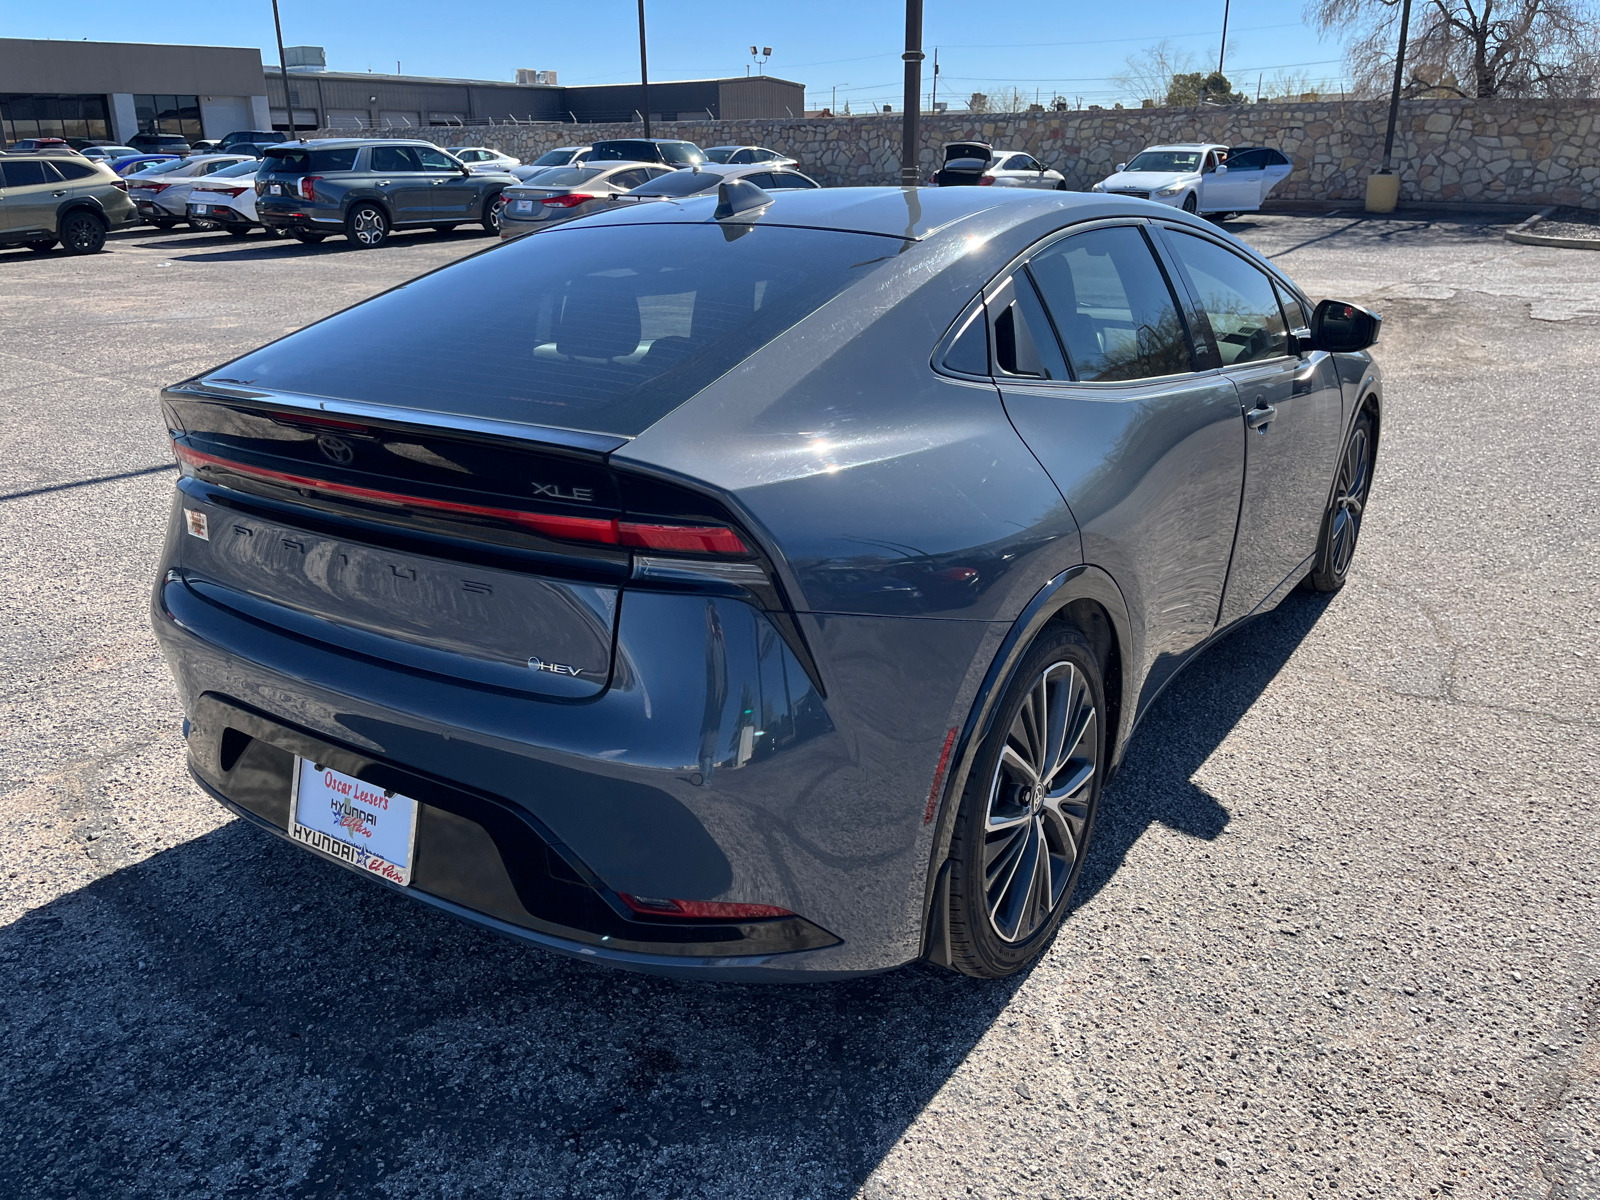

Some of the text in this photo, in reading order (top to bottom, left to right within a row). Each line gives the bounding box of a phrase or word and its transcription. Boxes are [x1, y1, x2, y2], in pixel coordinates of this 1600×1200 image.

[531, 482, 593, 501] XLE
[233, 524, 494, 596] PRIUS
[540, 661, 584, 676] HEV
[324, 771, 389, 811] Oscar Leeser's
[330, 798, 377, 827] HYUNDAI
[341, 816, 356, 827] El
[352, 819, 373, 838] Paso
[293, 823, 356, 862] HYUNDAI
[368, 859, 385, 872] El
[382, 864, 404, 883] Paso
